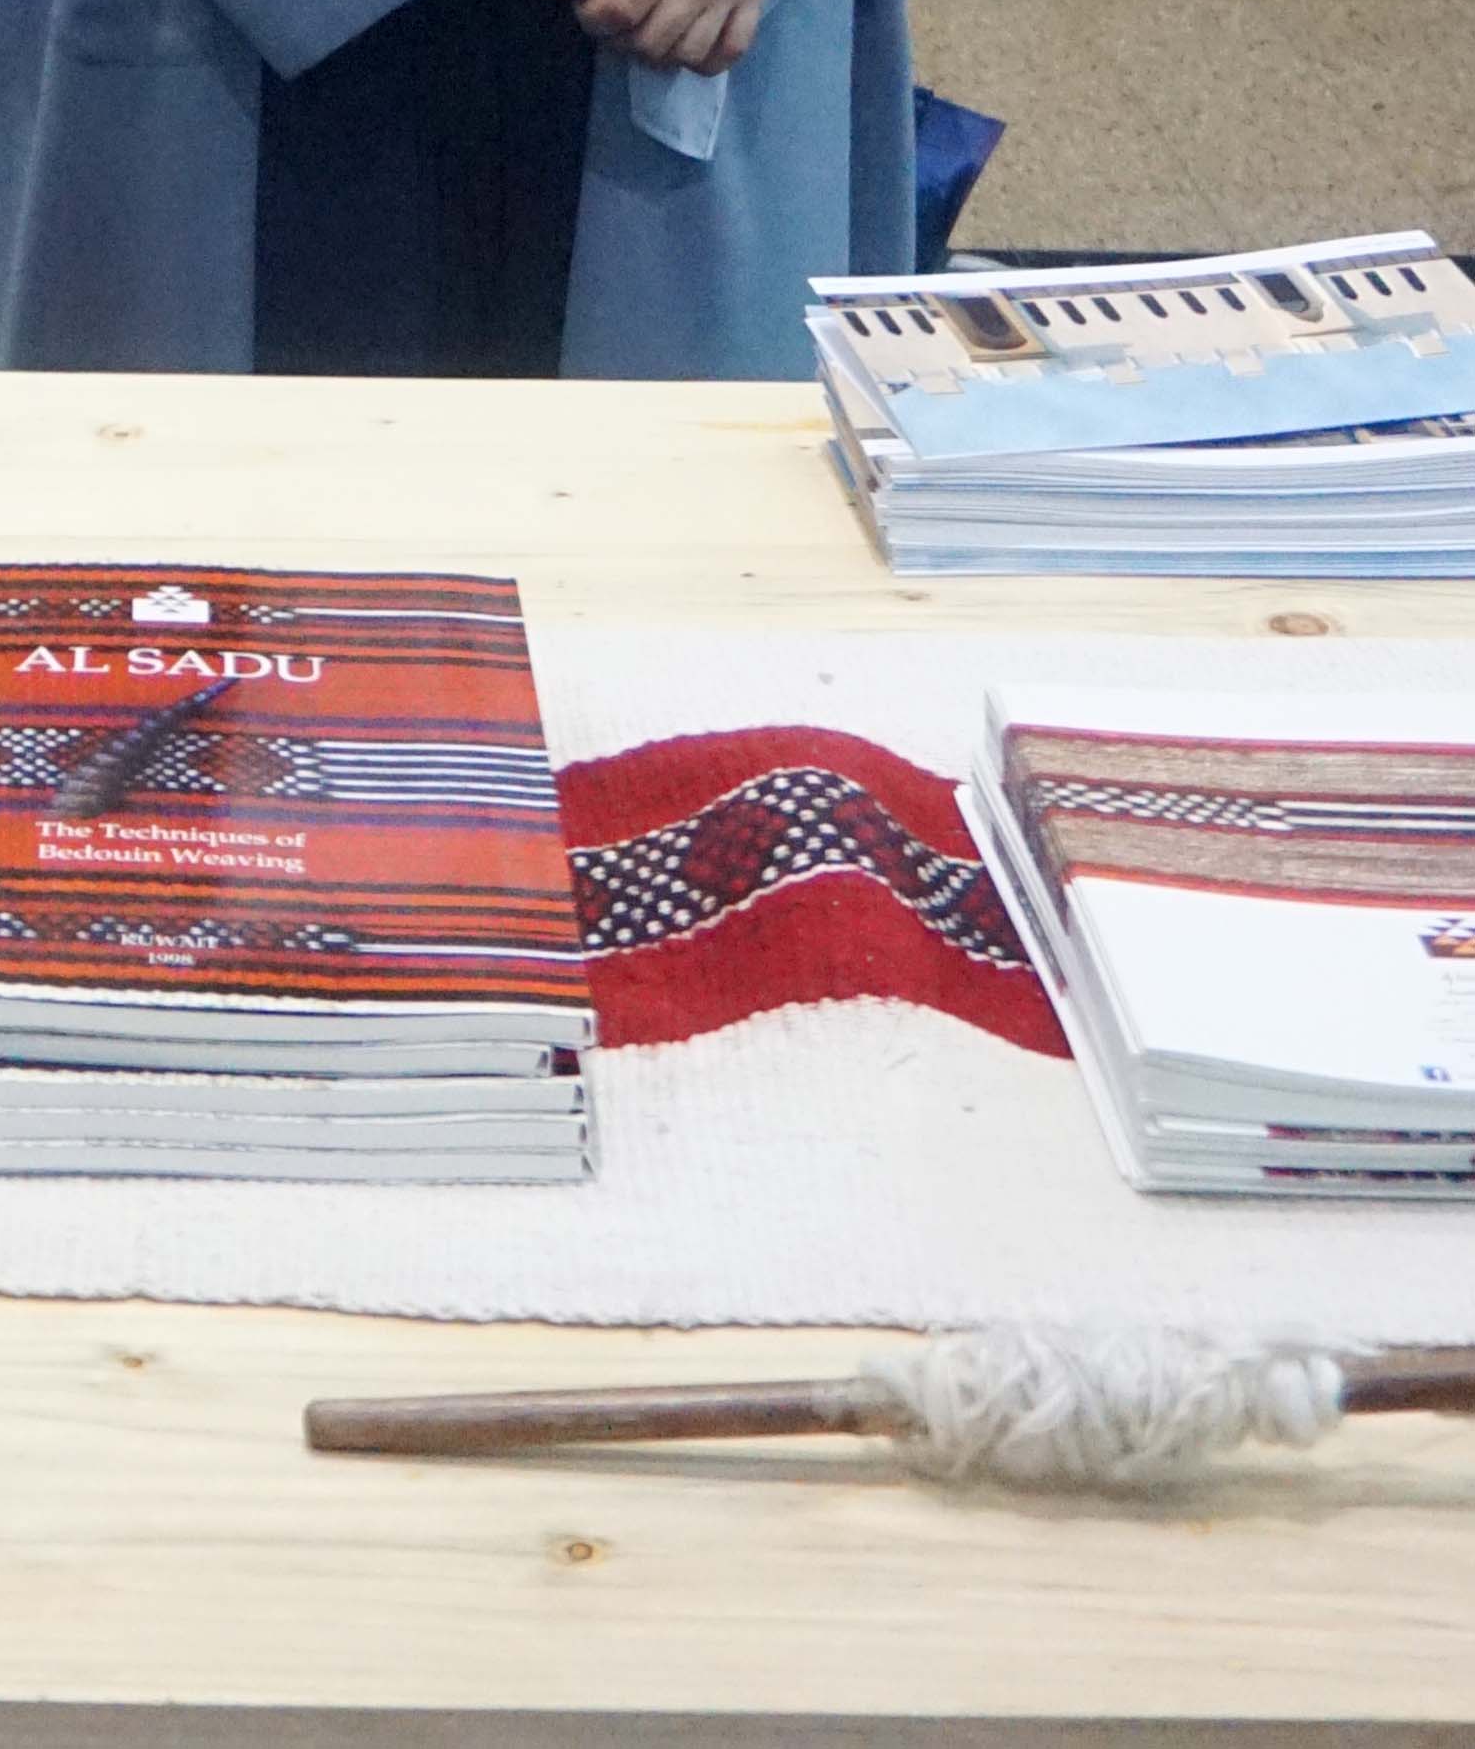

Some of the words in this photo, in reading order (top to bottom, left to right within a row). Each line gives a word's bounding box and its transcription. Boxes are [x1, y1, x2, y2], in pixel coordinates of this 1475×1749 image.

[13, 644, 112, 678] AL
[126, 648, 325, 685] SADU
[34, 820, 94, 839] The
[97, 822, 271, 849] Techniques
[274, 831, 309, 849] of
[36, 842, 165, 864] Bedouin
[169, 847, 308, 875] Weaving
[120, 933, 222, 950] KUWAIT
